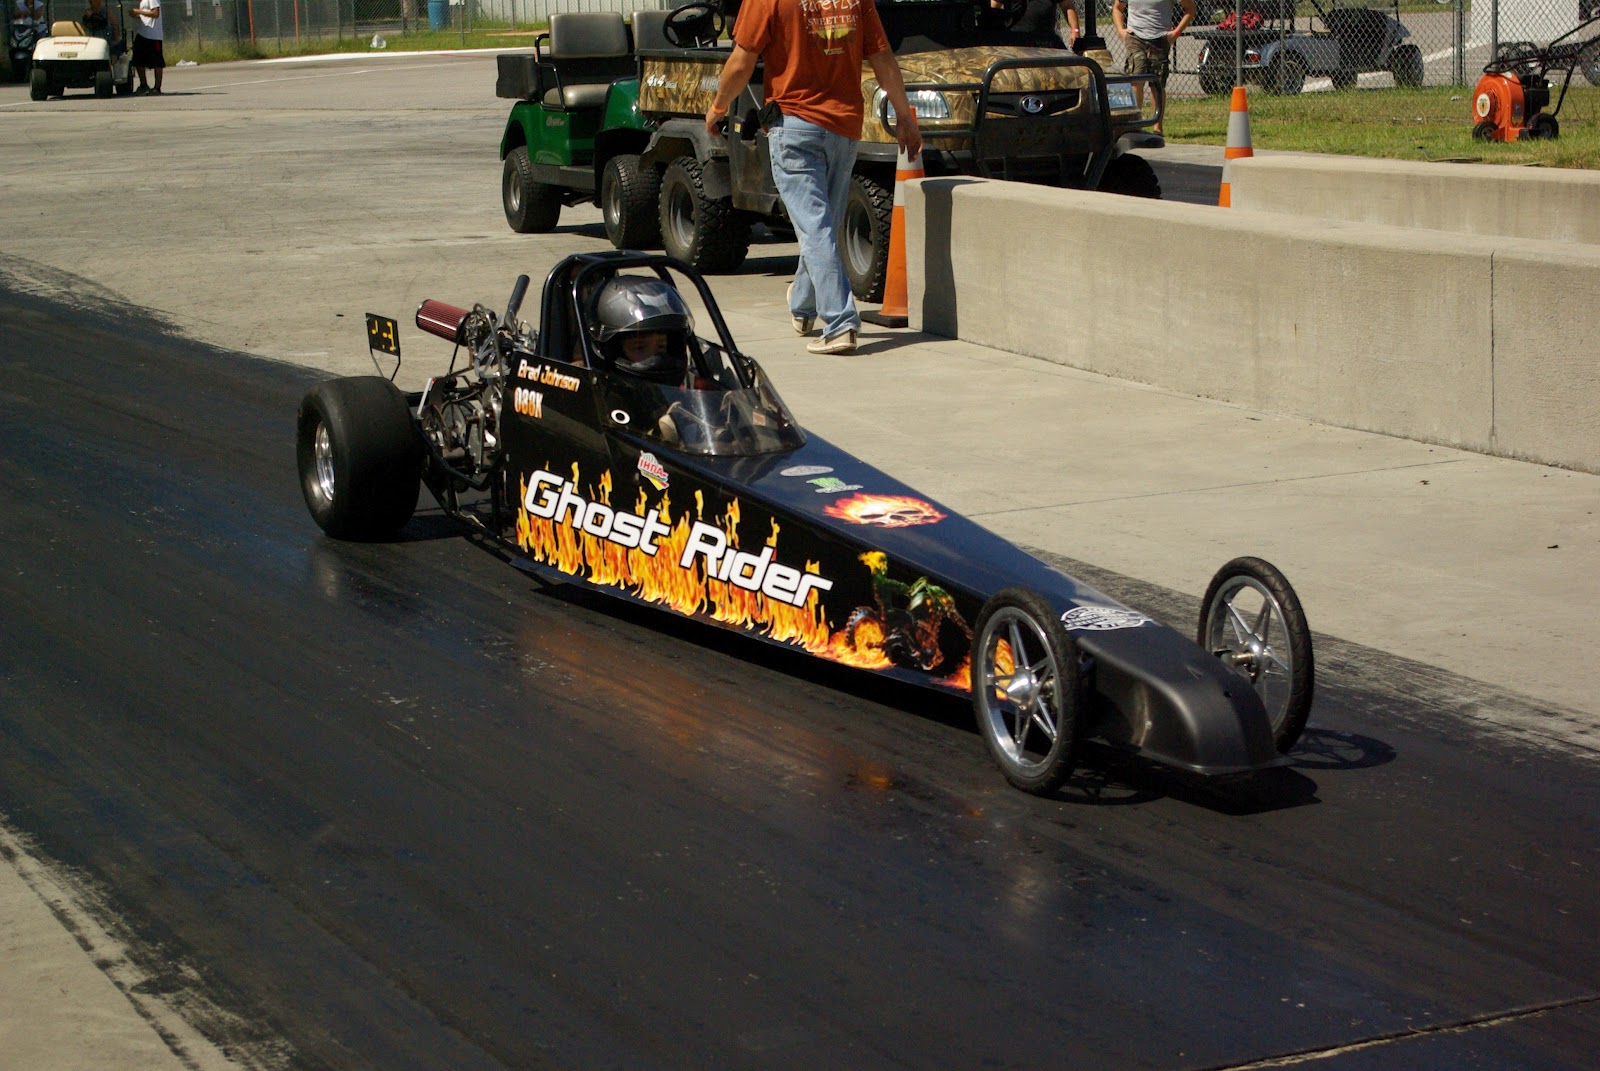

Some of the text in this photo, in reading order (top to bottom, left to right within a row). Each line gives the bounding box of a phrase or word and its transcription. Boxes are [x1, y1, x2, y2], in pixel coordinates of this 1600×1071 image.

[646, 74, 666, 87] 4x4
[517, 358, 580, 392] Brad Johnson
[524, 469, 834, 608] Ghost Rider
